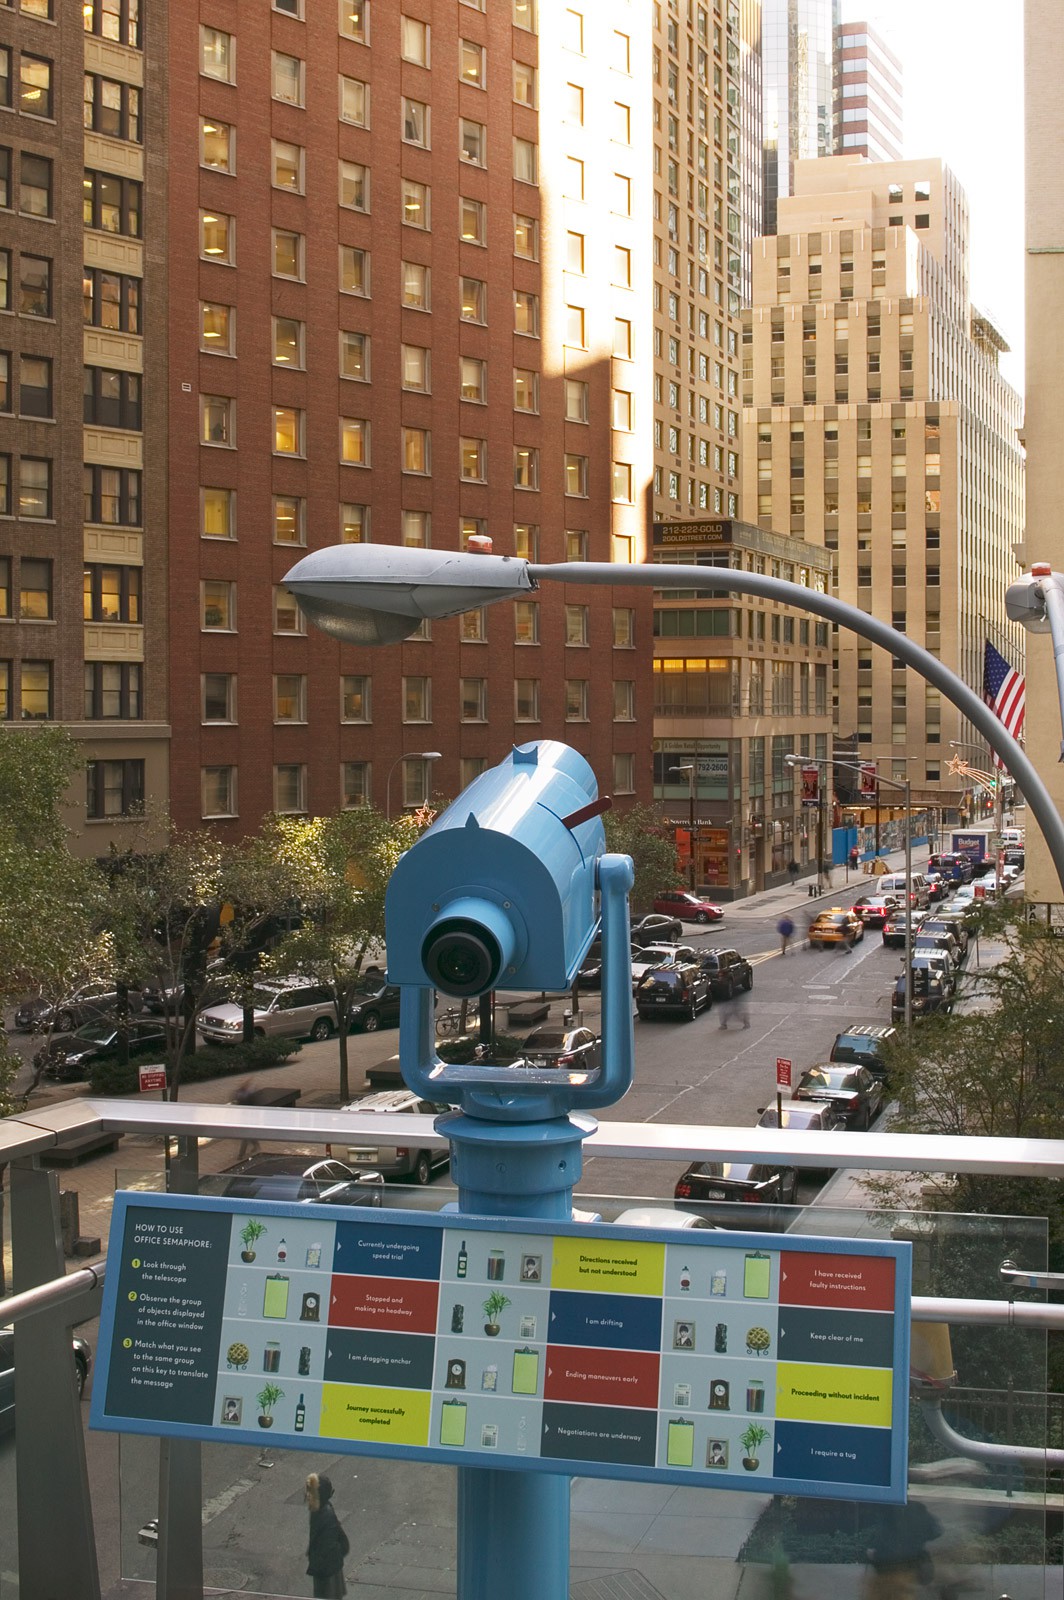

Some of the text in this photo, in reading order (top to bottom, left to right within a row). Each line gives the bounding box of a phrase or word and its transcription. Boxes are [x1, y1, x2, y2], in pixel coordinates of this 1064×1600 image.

[662, 524, 723, 534] 212-222-GOLD
[662, 534, 723, 543] 2GOLDSTREET.COM
[958, 838, 980, 847] Budget
[134, 1236, 212, 1248] OFFICE SEMAPHORE:
[358, 1240, 419, 1252] Currently undergoing
[372, 1253, 389, 1261] speed
[580, 1255, 610, 1264] Directions
[160, 1262, 186, 1272] through
[602, 1268, 637, 1276] understood
[154, 1274, 186, 1283] telescope
[810, 1281, 828, 1290] faulty
[140, 1293, 168, 1302] Observe
[366, 1294, 390, 1303] Stopped
[147, 1306, 171, 1316] objects
[172, 1308, 205, 1318] displayed
[355, 1305, 376, 1314] making
[386, 1307, 412, 1316] headway
[157, 1320, 176, 1328] office
[600, 1319, 623, 1328] drifting
[810, 1332, 826, 1340] Keep
[135, 1340, 156, 1348] Match
[158, 1342, 174, 1350] what
[362, 1355, 388, 1364] dragging
[156, 1366, 167, 1376] key
[178, 1370, 208, 1378] translate
[566, 1370, 586, 1380] Ending
[622, 1375, 638, 1384] early
[144, 1380, 173, 1388] message
[791, 1388, 827, 1399] Proceeding
[854, 1393, 879, 1401] incident
[346, 1404, 405, 1416] Journey successfully
[558, 1427, 598, 1437] Negotiations
[611, 1433, 641, 1442] underway
[814, 1450, 838, 1459] require
